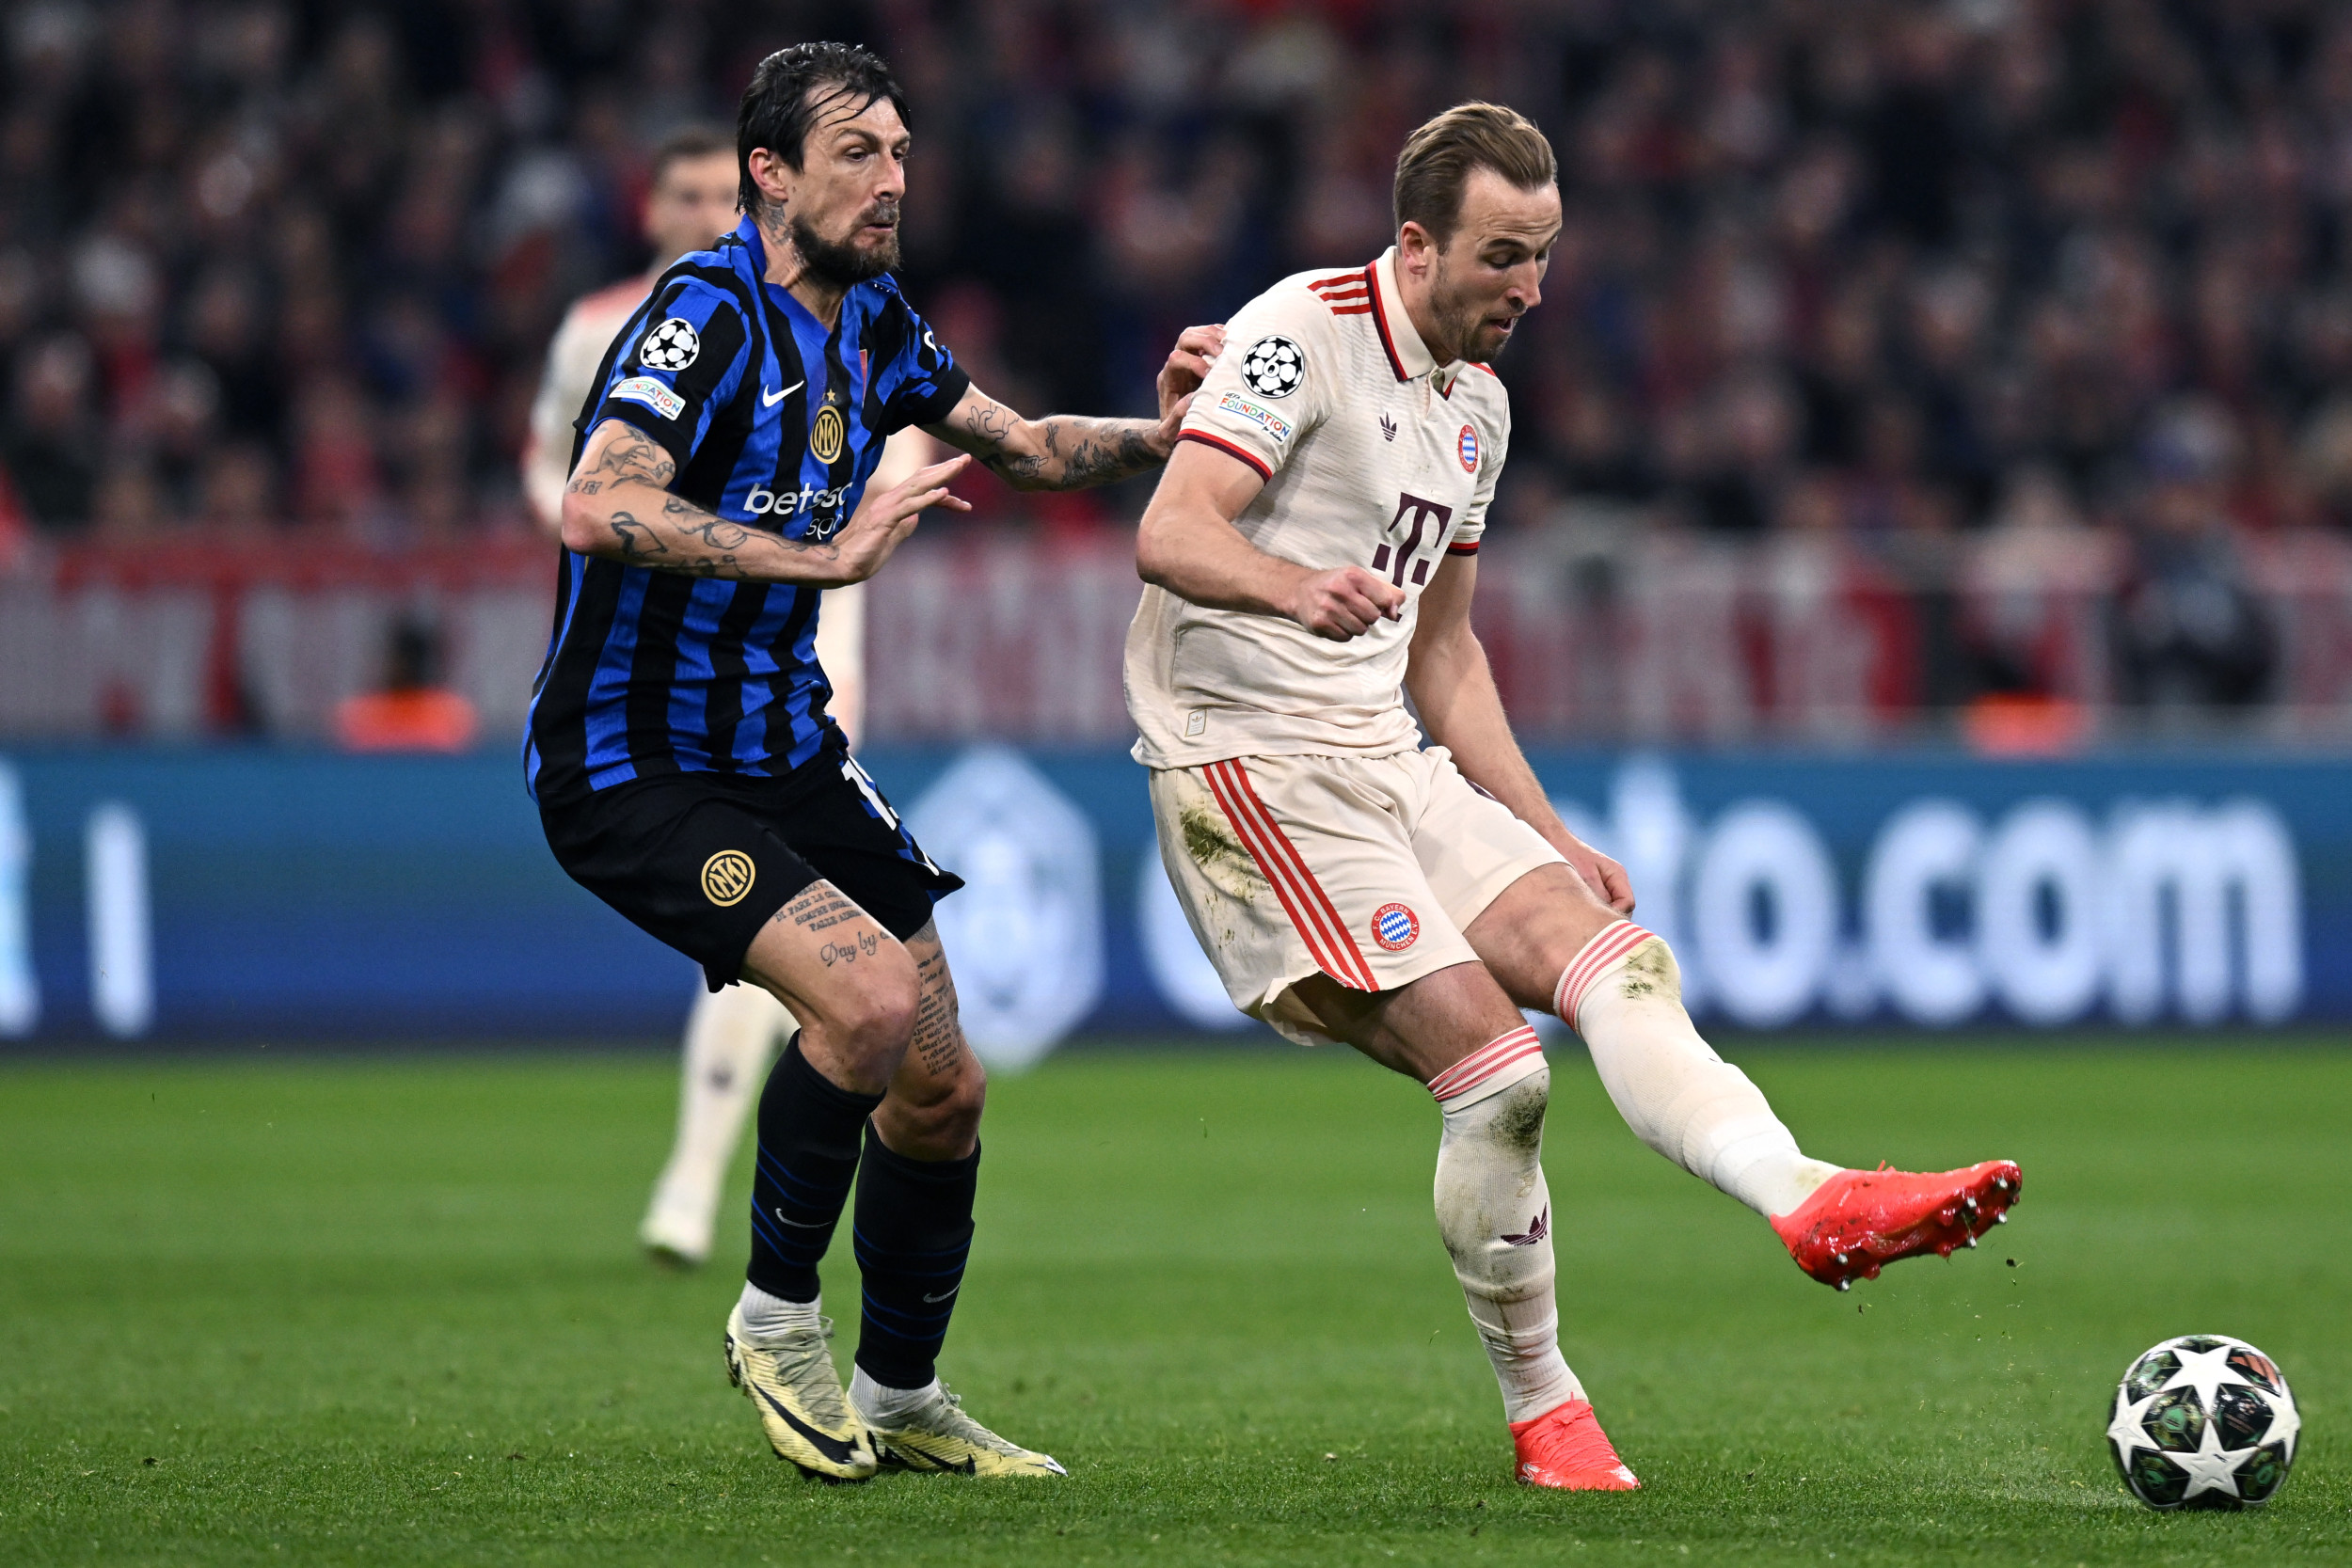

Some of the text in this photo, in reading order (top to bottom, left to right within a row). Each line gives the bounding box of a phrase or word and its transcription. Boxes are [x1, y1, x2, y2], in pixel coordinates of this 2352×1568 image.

[1220, 397, 1291, 437] FOUNDATION
[743, 482, 853, 515] betsso
[1380, 904, 1409, 914] BAYERN
[820, 931, 878, 967] Day by
